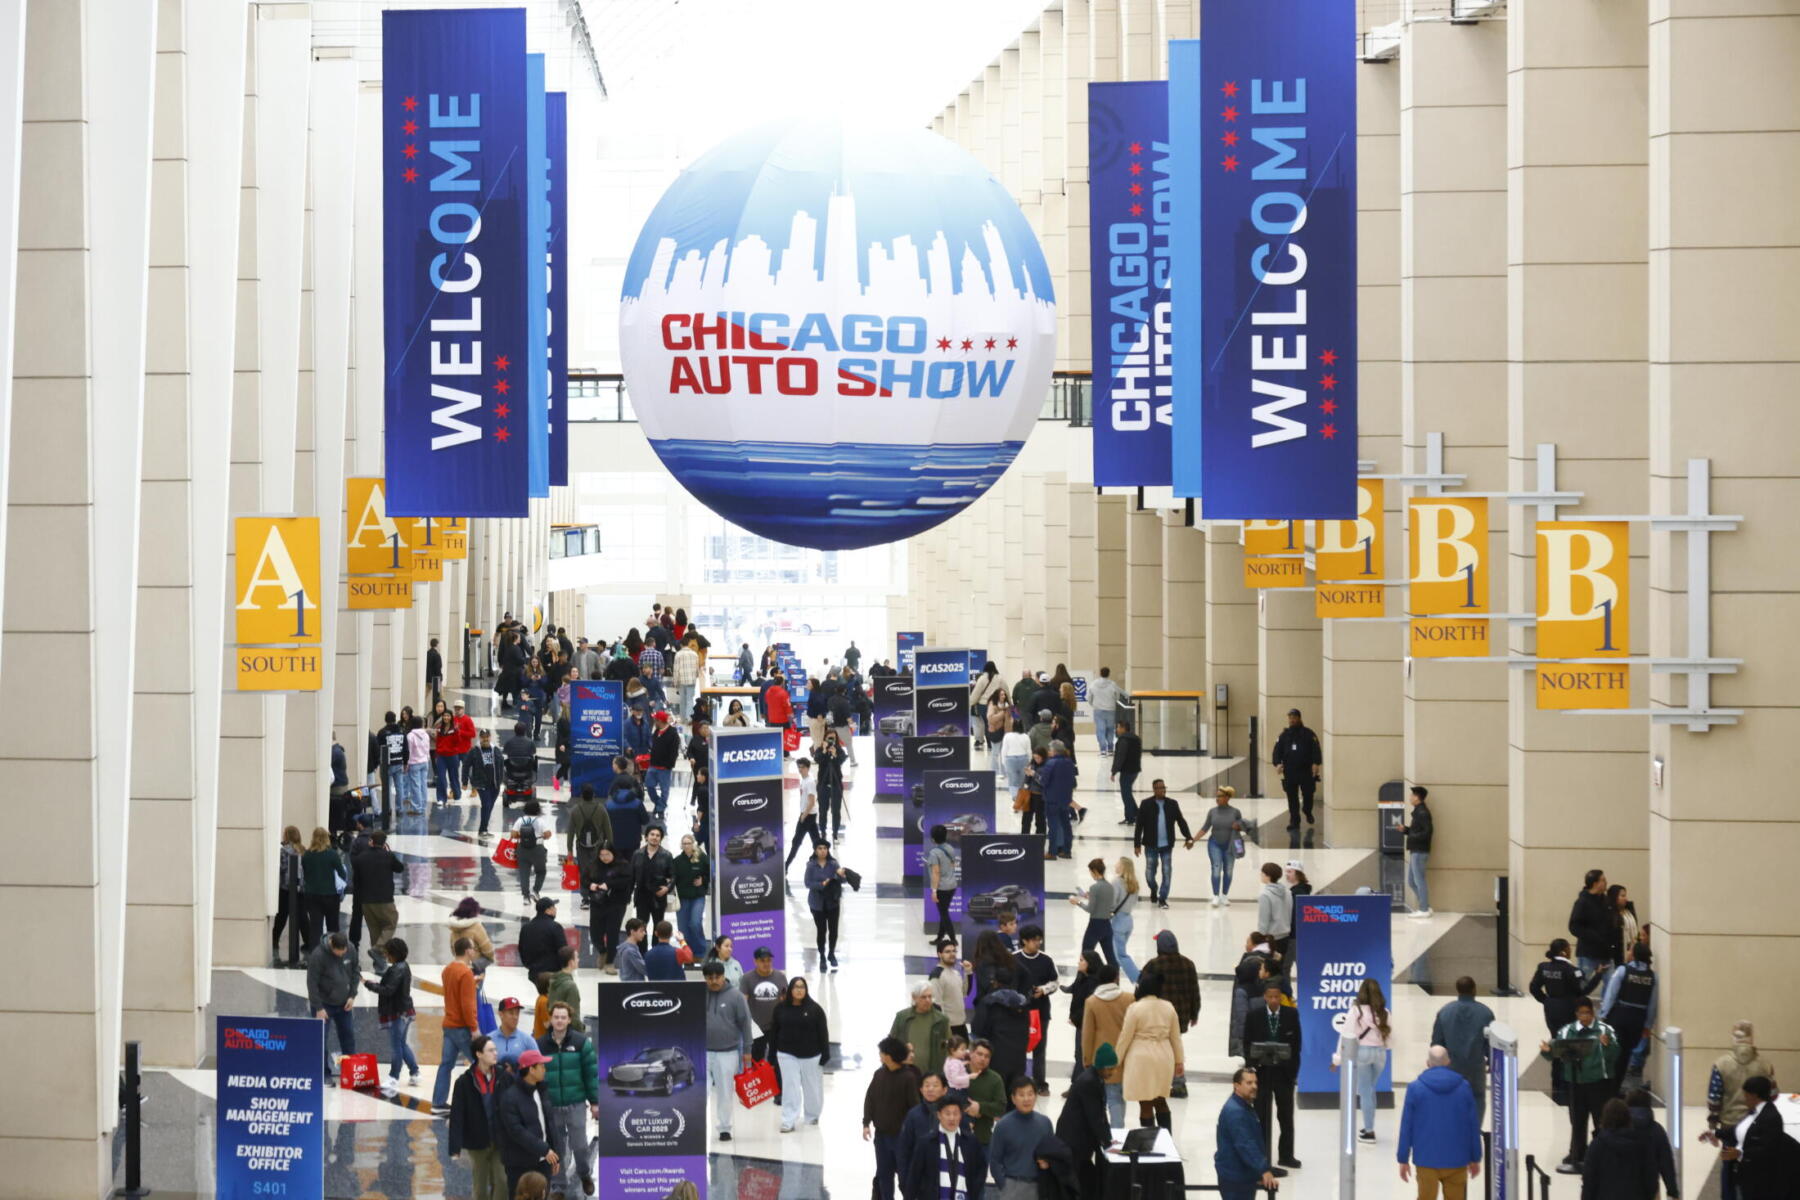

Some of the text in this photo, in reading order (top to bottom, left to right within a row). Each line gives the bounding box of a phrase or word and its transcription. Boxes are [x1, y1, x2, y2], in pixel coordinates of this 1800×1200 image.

[1251, 77, 1308, 449] WELCOME
[429, 93, 482, 450] WELCOME
[661, 311, 928, 354] CHICAGO
[1109, 222, 1151, 431] CHICAGO
[669, 355, 1015, 400] AUTO SHOW
[1247, 562, 1302, 576] NORTH
[351, 583, 408, 596] SOUTH
[1319, 590, 1382, 604] NORTH
[1414, 625, 1486, 641] NORTH
[241, 656, 316, 673] SOUTH
[920, 662, 965, 674] #CAS2025
[1541, 672, 1625, 690] NORTH
[722, 748, 776, 764] #CAS2025
[737, 798, 763, 806] cars.com
[986, 848, 1020, 856] cars.com
[1303, 905, 1344, 914] CHICAGO
[1303, 914, 1359, 923] AUTO SHOW
[1321, 962, 1366, 977] AUTO
[1628, 974, 1652, 986] POLICE
[224, 1028, 270, 1039] CHICAGO
[224, 1039, 287, 1051] AUTO SHOW
[227, 1075, 312, 1091] MEDIA OFFICE
[743, 1077, 761, 1091] Let's
[746, 1088, 759, 1098] Go
[250, 1097, 290, 1110] SHOW
[226, 1109, 313, 1124] MANAGEMENT
[248, 1123, 291, 1136] OFFICE
[236, 1144, 303, 1159] EXHIBITOR
[248, 1158, 290, 1171] OFFICE
[252, 1181, 287, 1195] S401
